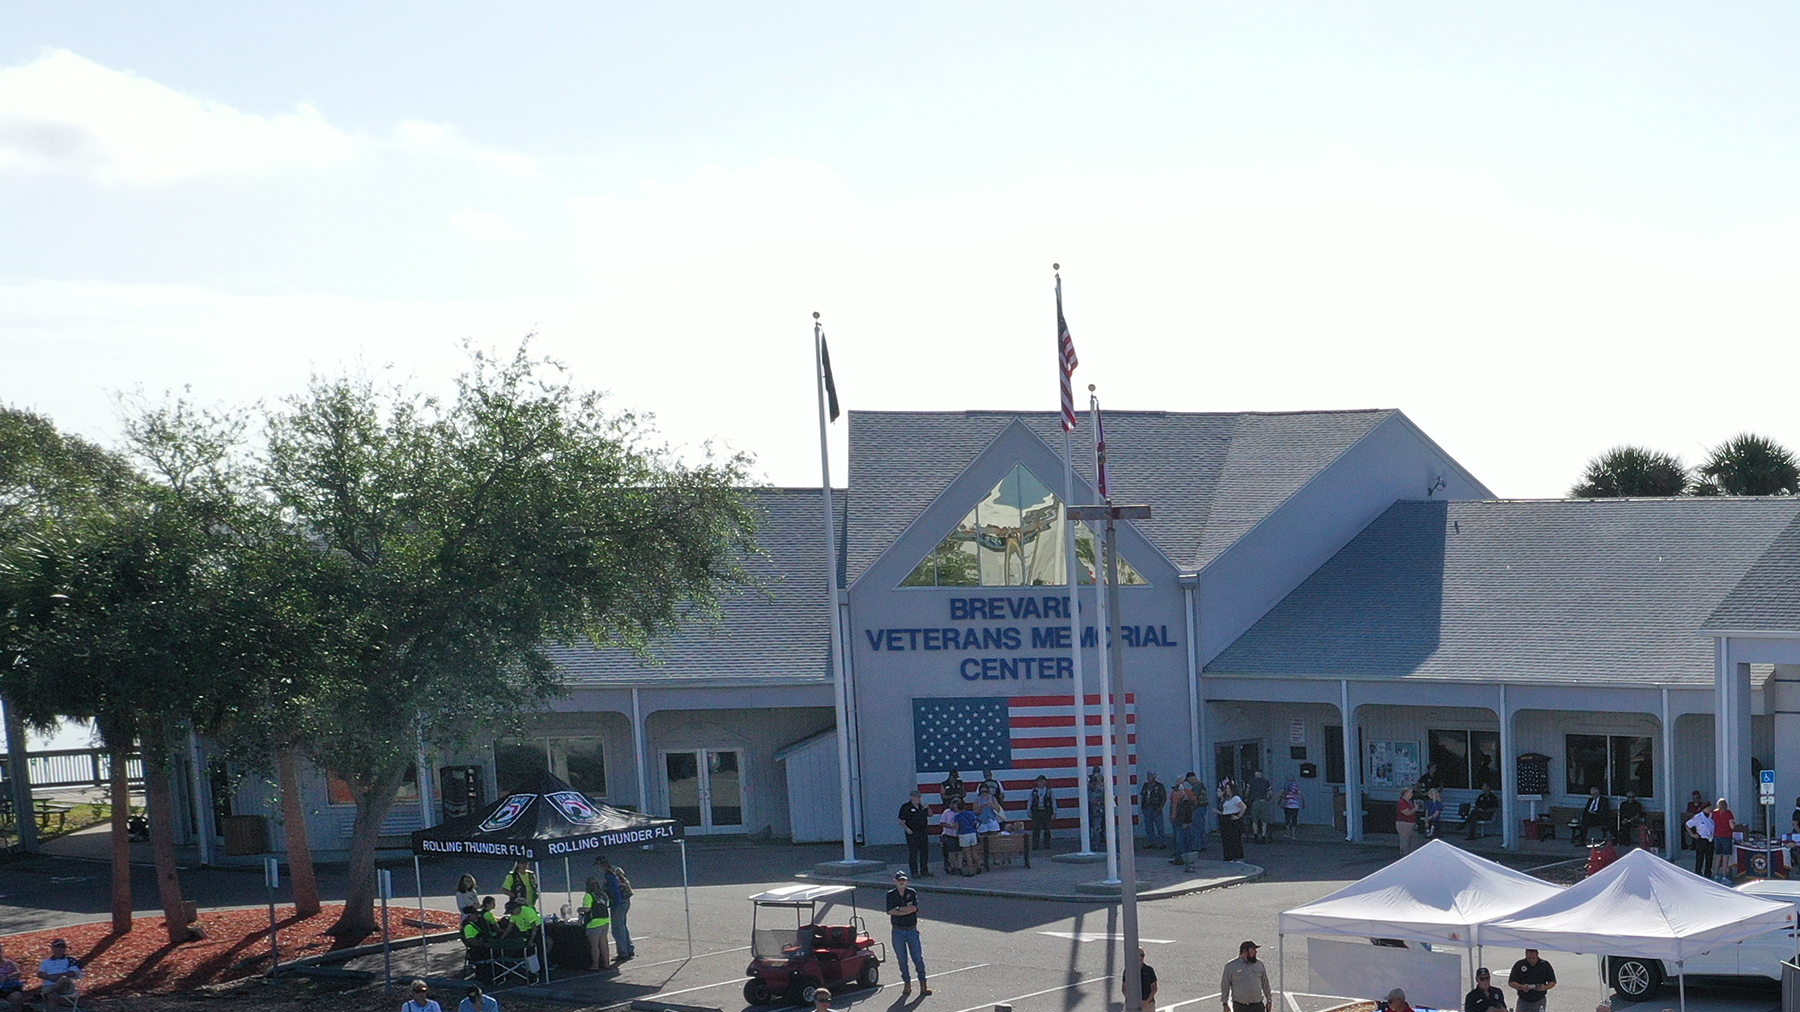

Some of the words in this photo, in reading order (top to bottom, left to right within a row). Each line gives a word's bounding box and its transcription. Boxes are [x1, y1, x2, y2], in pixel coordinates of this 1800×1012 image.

[950, 597, 1082, 620] BREVARD
[865, 626, 1021, 651] VETERANS
[960, 657, 1075, 681] CENTER
[422, 840, 462, 853] ROLLING
[464, 841, 508, 855] THUNDER
[548, 837, 599, 855] ROLLING
[601, 829, 653, 847] THUNDER
